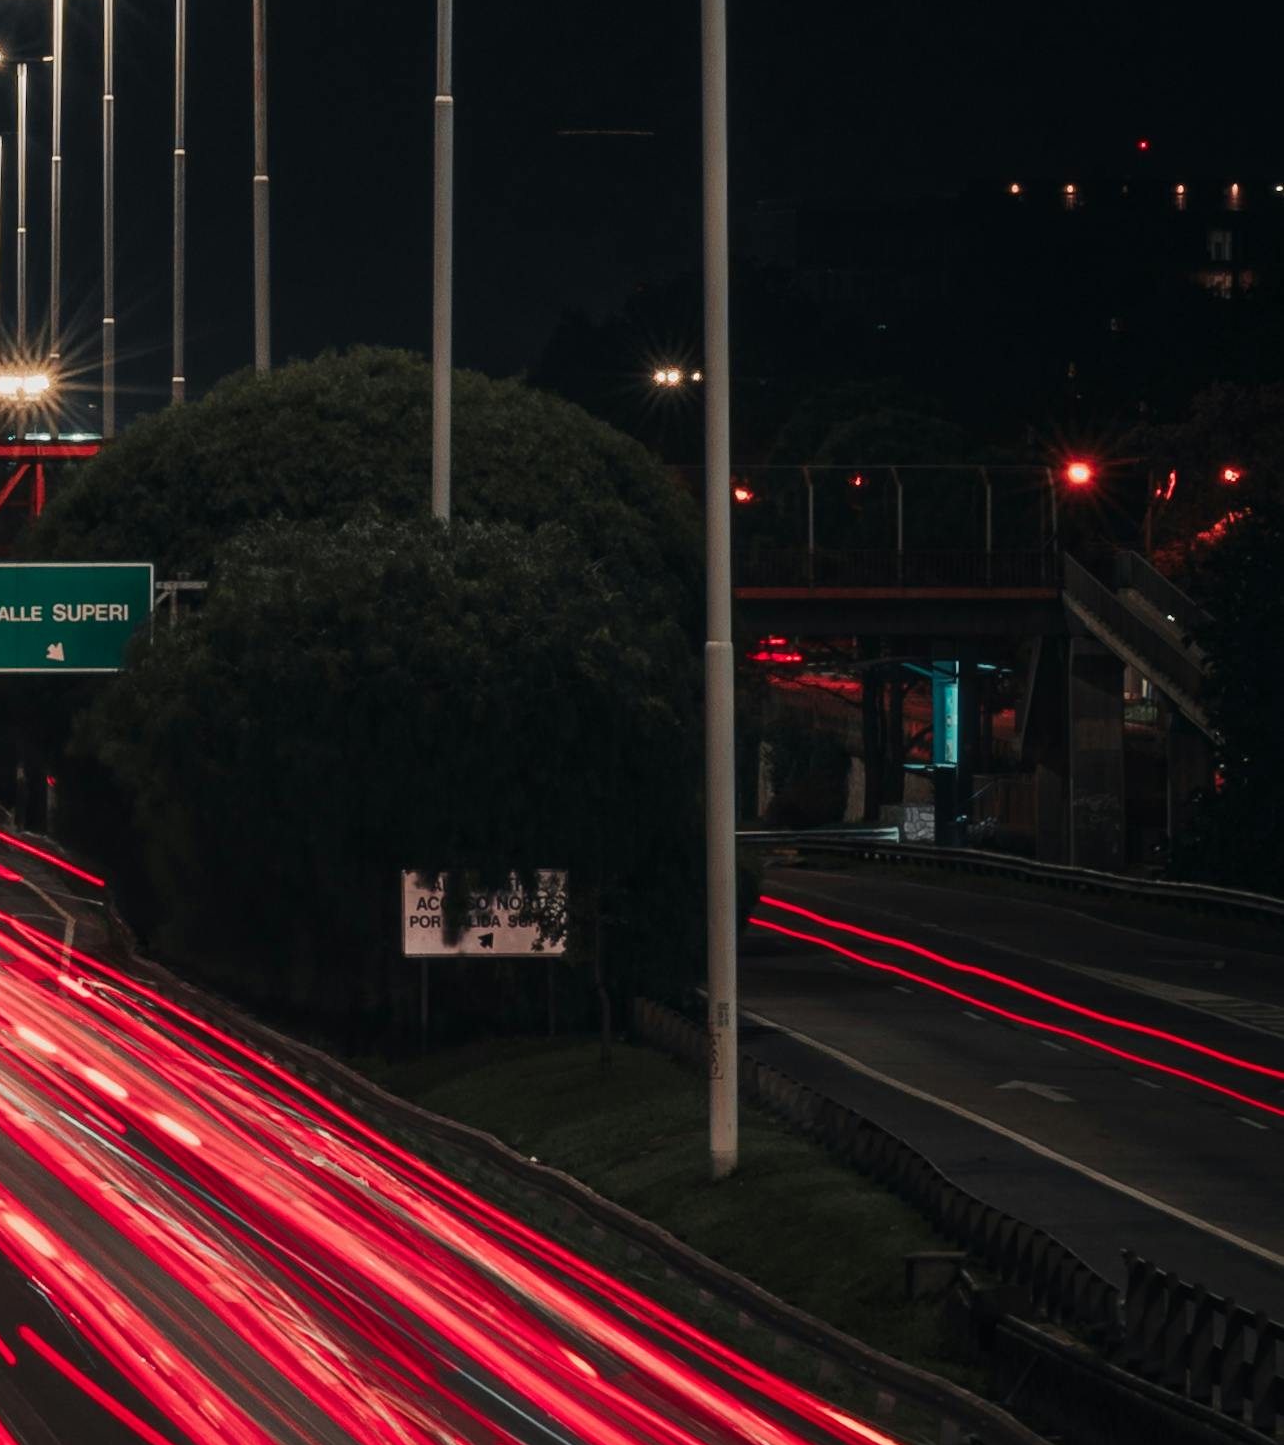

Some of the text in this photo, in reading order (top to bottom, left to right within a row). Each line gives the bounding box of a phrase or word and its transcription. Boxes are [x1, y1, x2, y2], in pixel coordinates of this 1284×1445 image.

[52, 604, 129, 622] SUPERI
[417, 896, 488, 911] ACSO
[409, 915, 441, 929] POR
[450, 915, 501, 928] ALIDA
